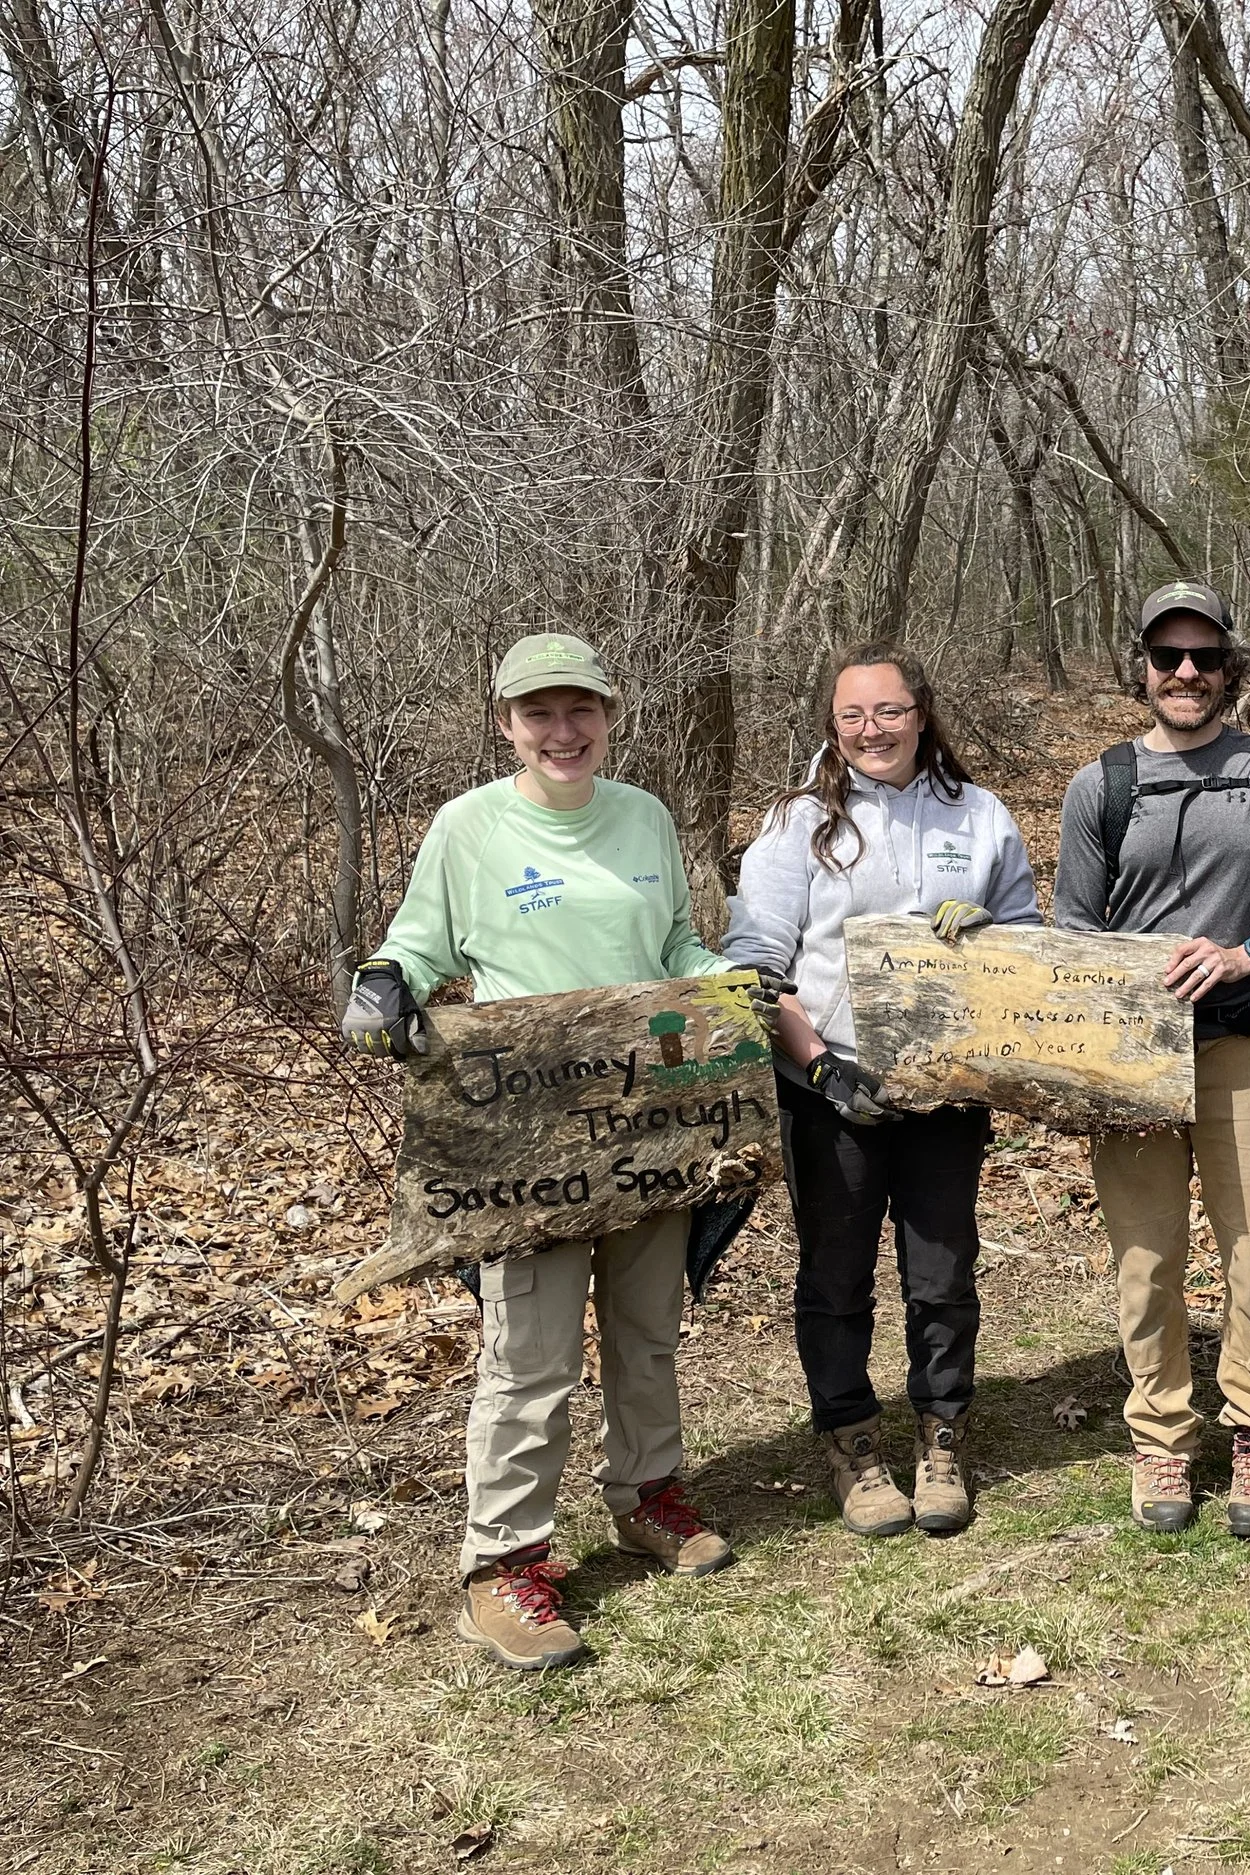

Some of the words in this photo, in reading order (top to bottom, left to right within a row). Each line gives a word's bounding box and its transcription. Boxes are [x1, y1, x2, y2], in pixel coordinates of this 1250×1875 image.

[936, 864, 967, 874] STAFF
[518, 895, 563, 914] STAFF
[879, 951, 968, 973] Amphibians
[982, 962, 1017, 975] have
[1066, 1012, 1086, 1023] on
[1102, 1010, 1144, 1026] Earth
[460, 1045, 637, 1108] Journey
[566, 1090, 769, 1150] Through
[425, 1169, 591, 1219] Sacred
